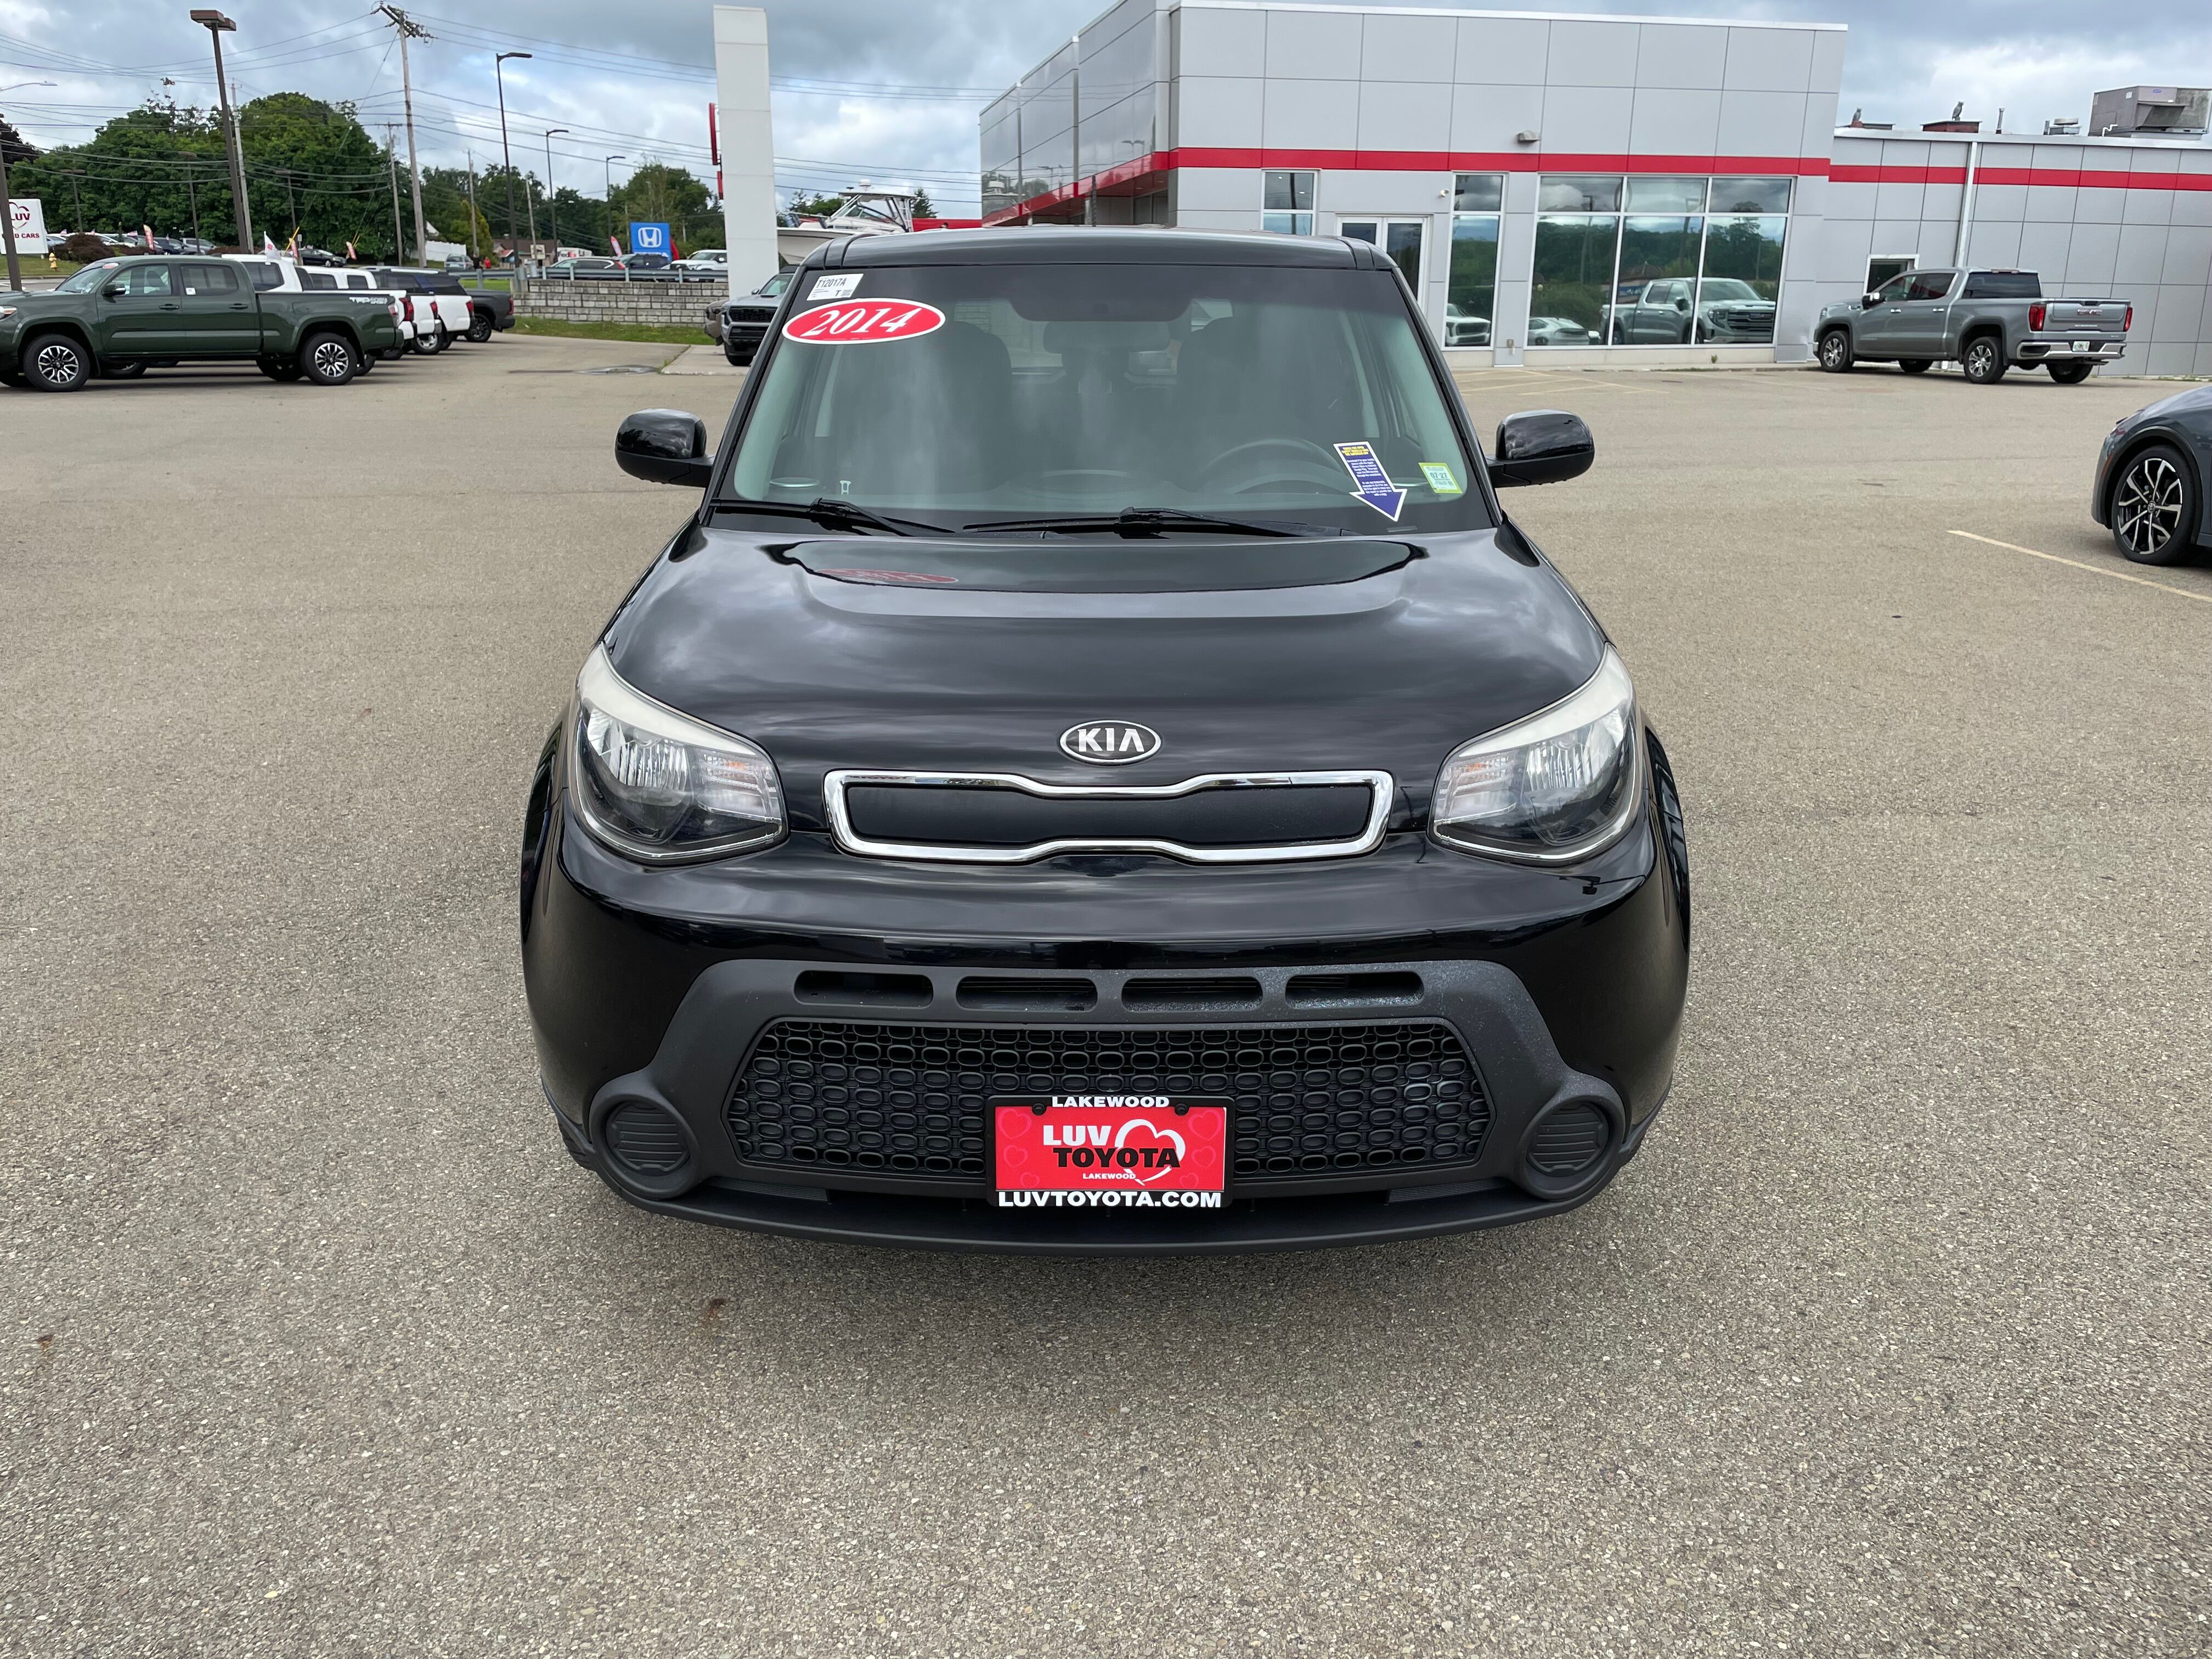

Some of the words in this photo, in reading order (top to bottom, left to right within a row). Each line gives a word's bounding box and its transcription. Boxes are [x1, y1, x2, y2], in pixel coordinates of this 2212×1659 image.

[816, 278, 847, 288] T12017A
[799, 308, 922, 337] 2014
[1077, 727, 1144, 752] KIA
[1052, 1096, 1169, 1107] LAKEWOOD
[1043, 1125, 1112, 1146] LUV
[1053, 1147, 1180, 1167] TOYOTA
[998, 1191, 1221, 1207] LUVTOYOTA.COM
